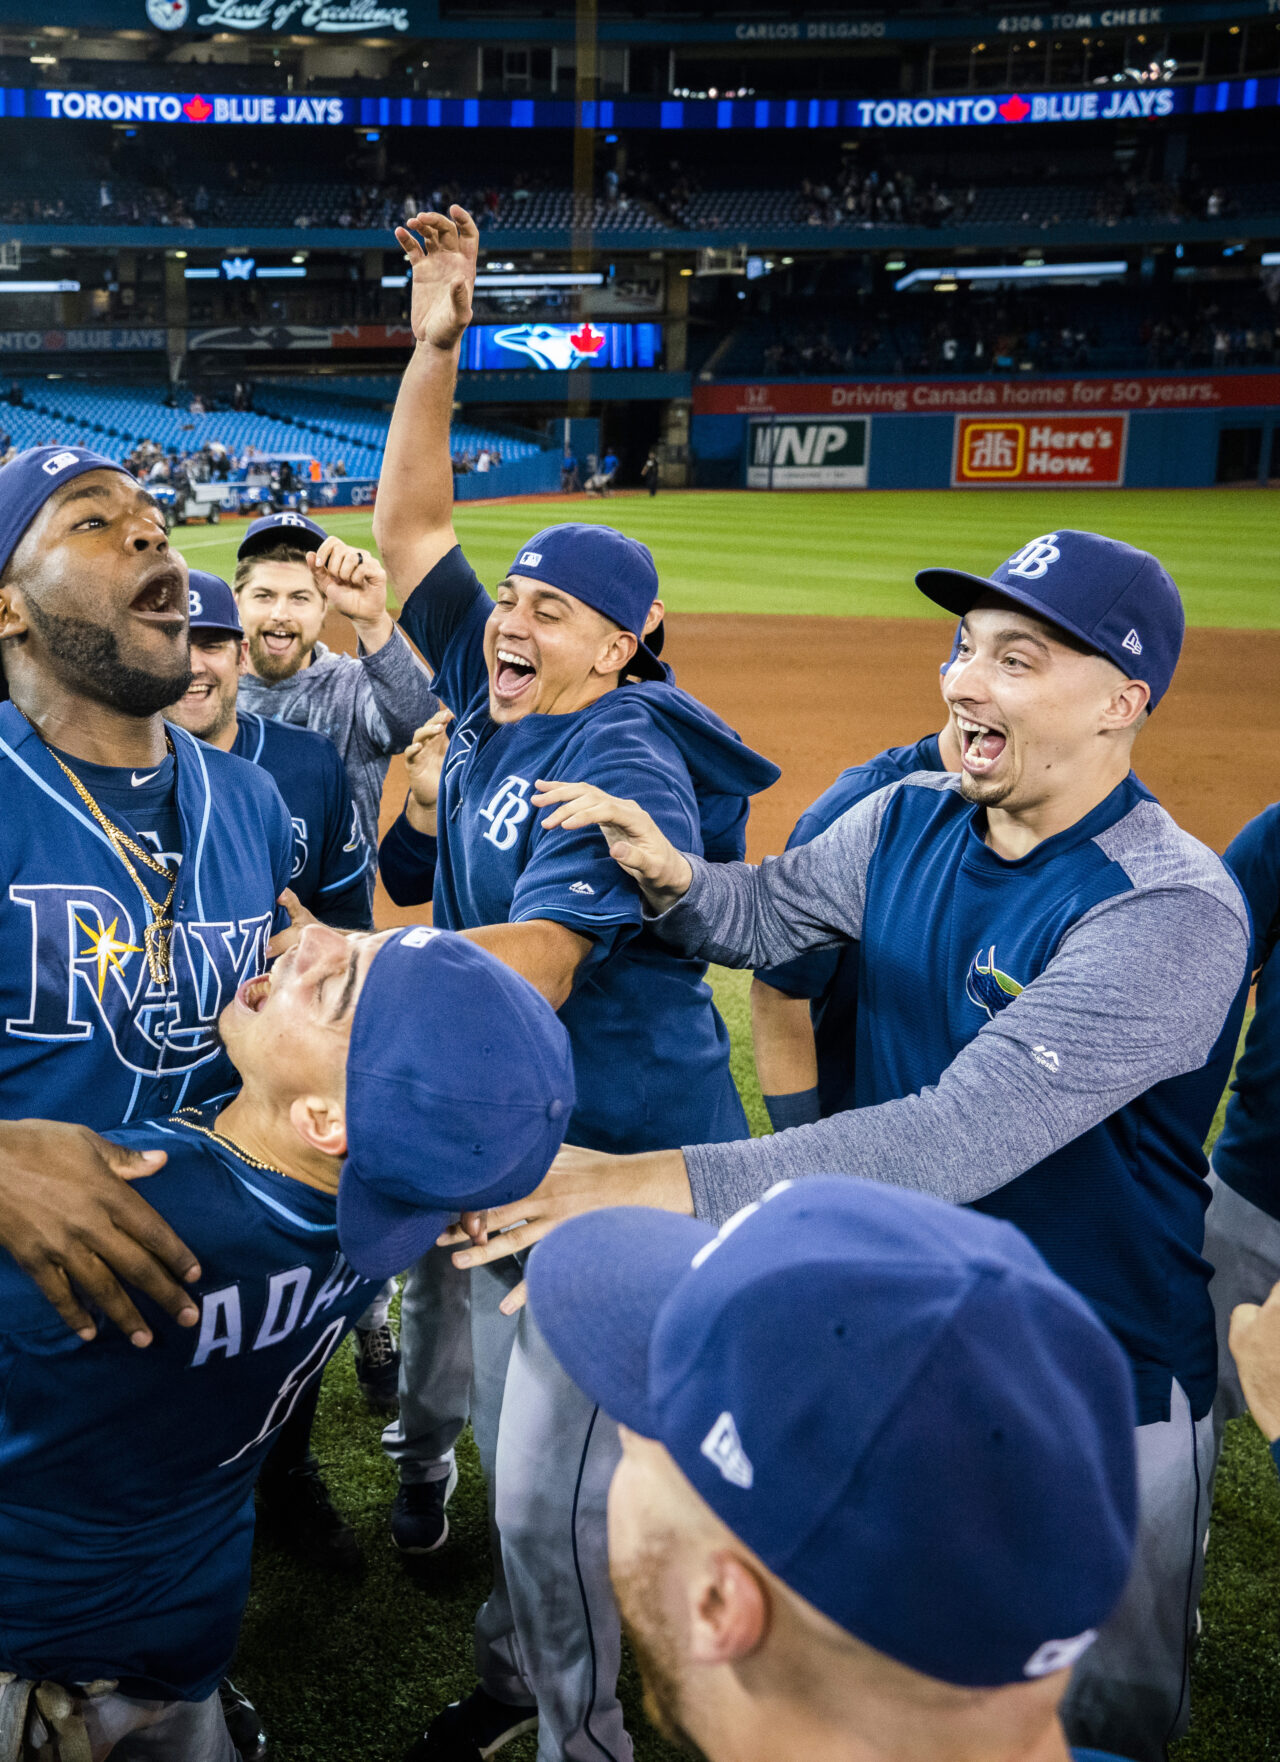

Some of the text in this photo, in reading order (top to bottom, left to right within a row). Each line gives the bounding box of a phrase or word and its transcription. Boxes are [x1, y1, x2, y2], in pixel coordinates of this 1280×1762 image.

[735, 22, 886, 40] CARLOS DELGADO
[1052, 14, 1093, 29] TOM
[1100, 8, 1163, 27] CHEEK
[45, 91, 344, 125] TORONTO BLUE JAYS
[858, 89, 1174, 128] TORONTO BLUE JAYS
[65, 330, 111, 349] BLUE
[116, 328, 165, 348] JAYS
[831, 382, 1220, 411] Driving Canada home for 50 years.
[1029, 427, 1112, 450] Here's
[1027, 450, 1093, 474] How.
[1007, 534, 1061, 580] TB
[479, 774, 531, 851] TB
